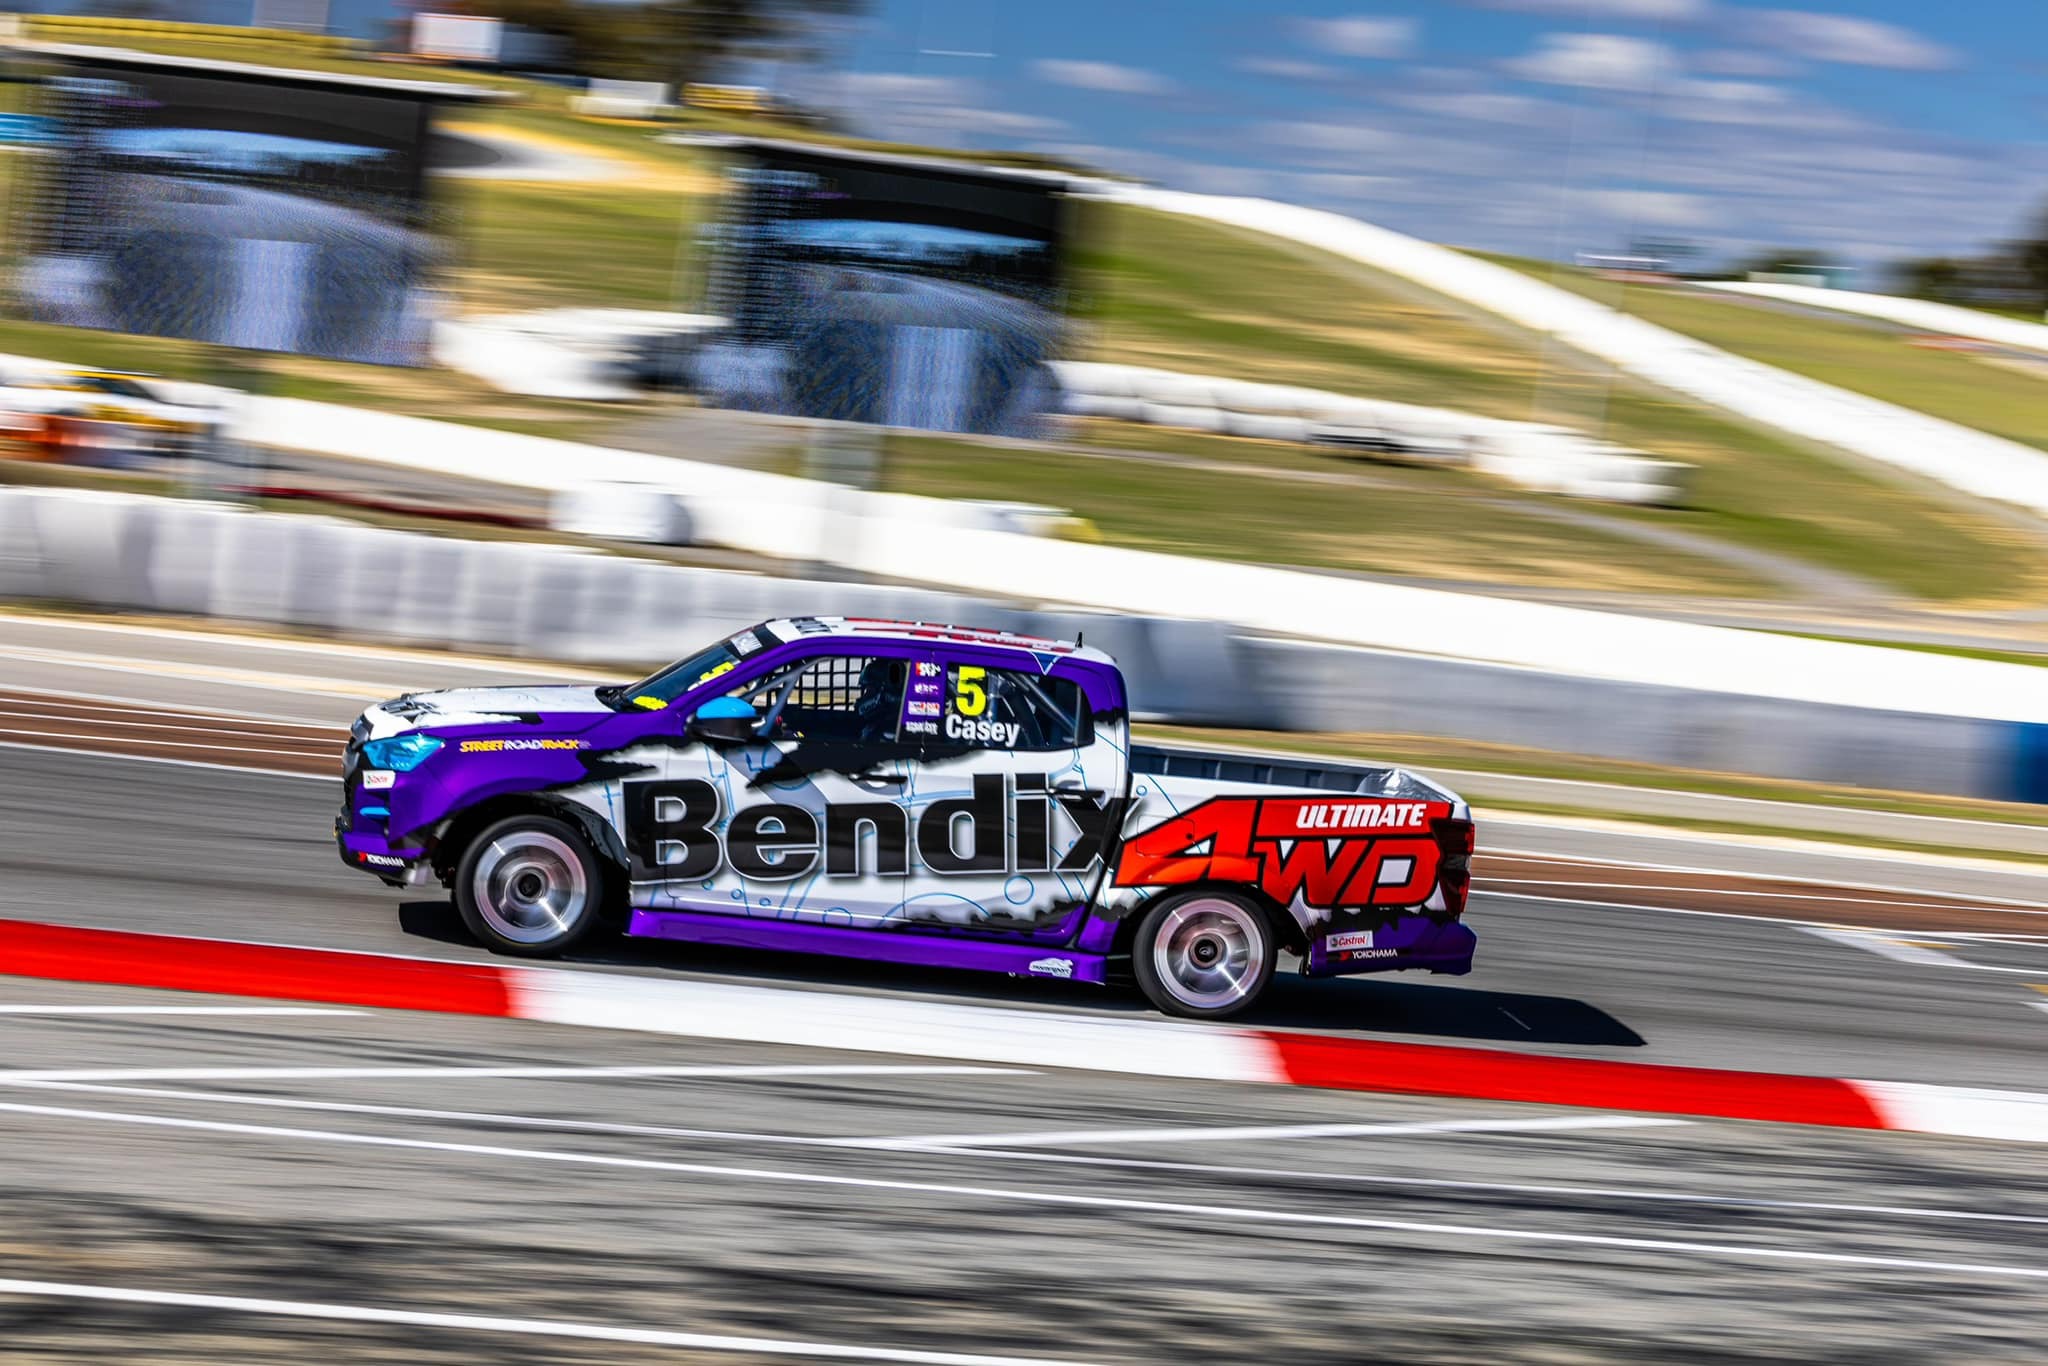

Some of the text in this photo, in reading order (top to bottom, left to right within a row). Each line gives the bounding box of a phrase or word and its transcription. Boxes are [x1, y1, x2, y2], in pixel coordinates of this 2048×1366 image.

[956, 665, 987, 716] 5
[945, 713, 1020, 748] Casey
[619, 772, 1145, 885] Bendix
[1296, 803, 1427, 829] ULTIMATE
[1111, 796, 1442, 908] 4WD
[1338, 935, 1366, 947] Castrol
[1352, 948, 1398, 960] YOKOHAMA
